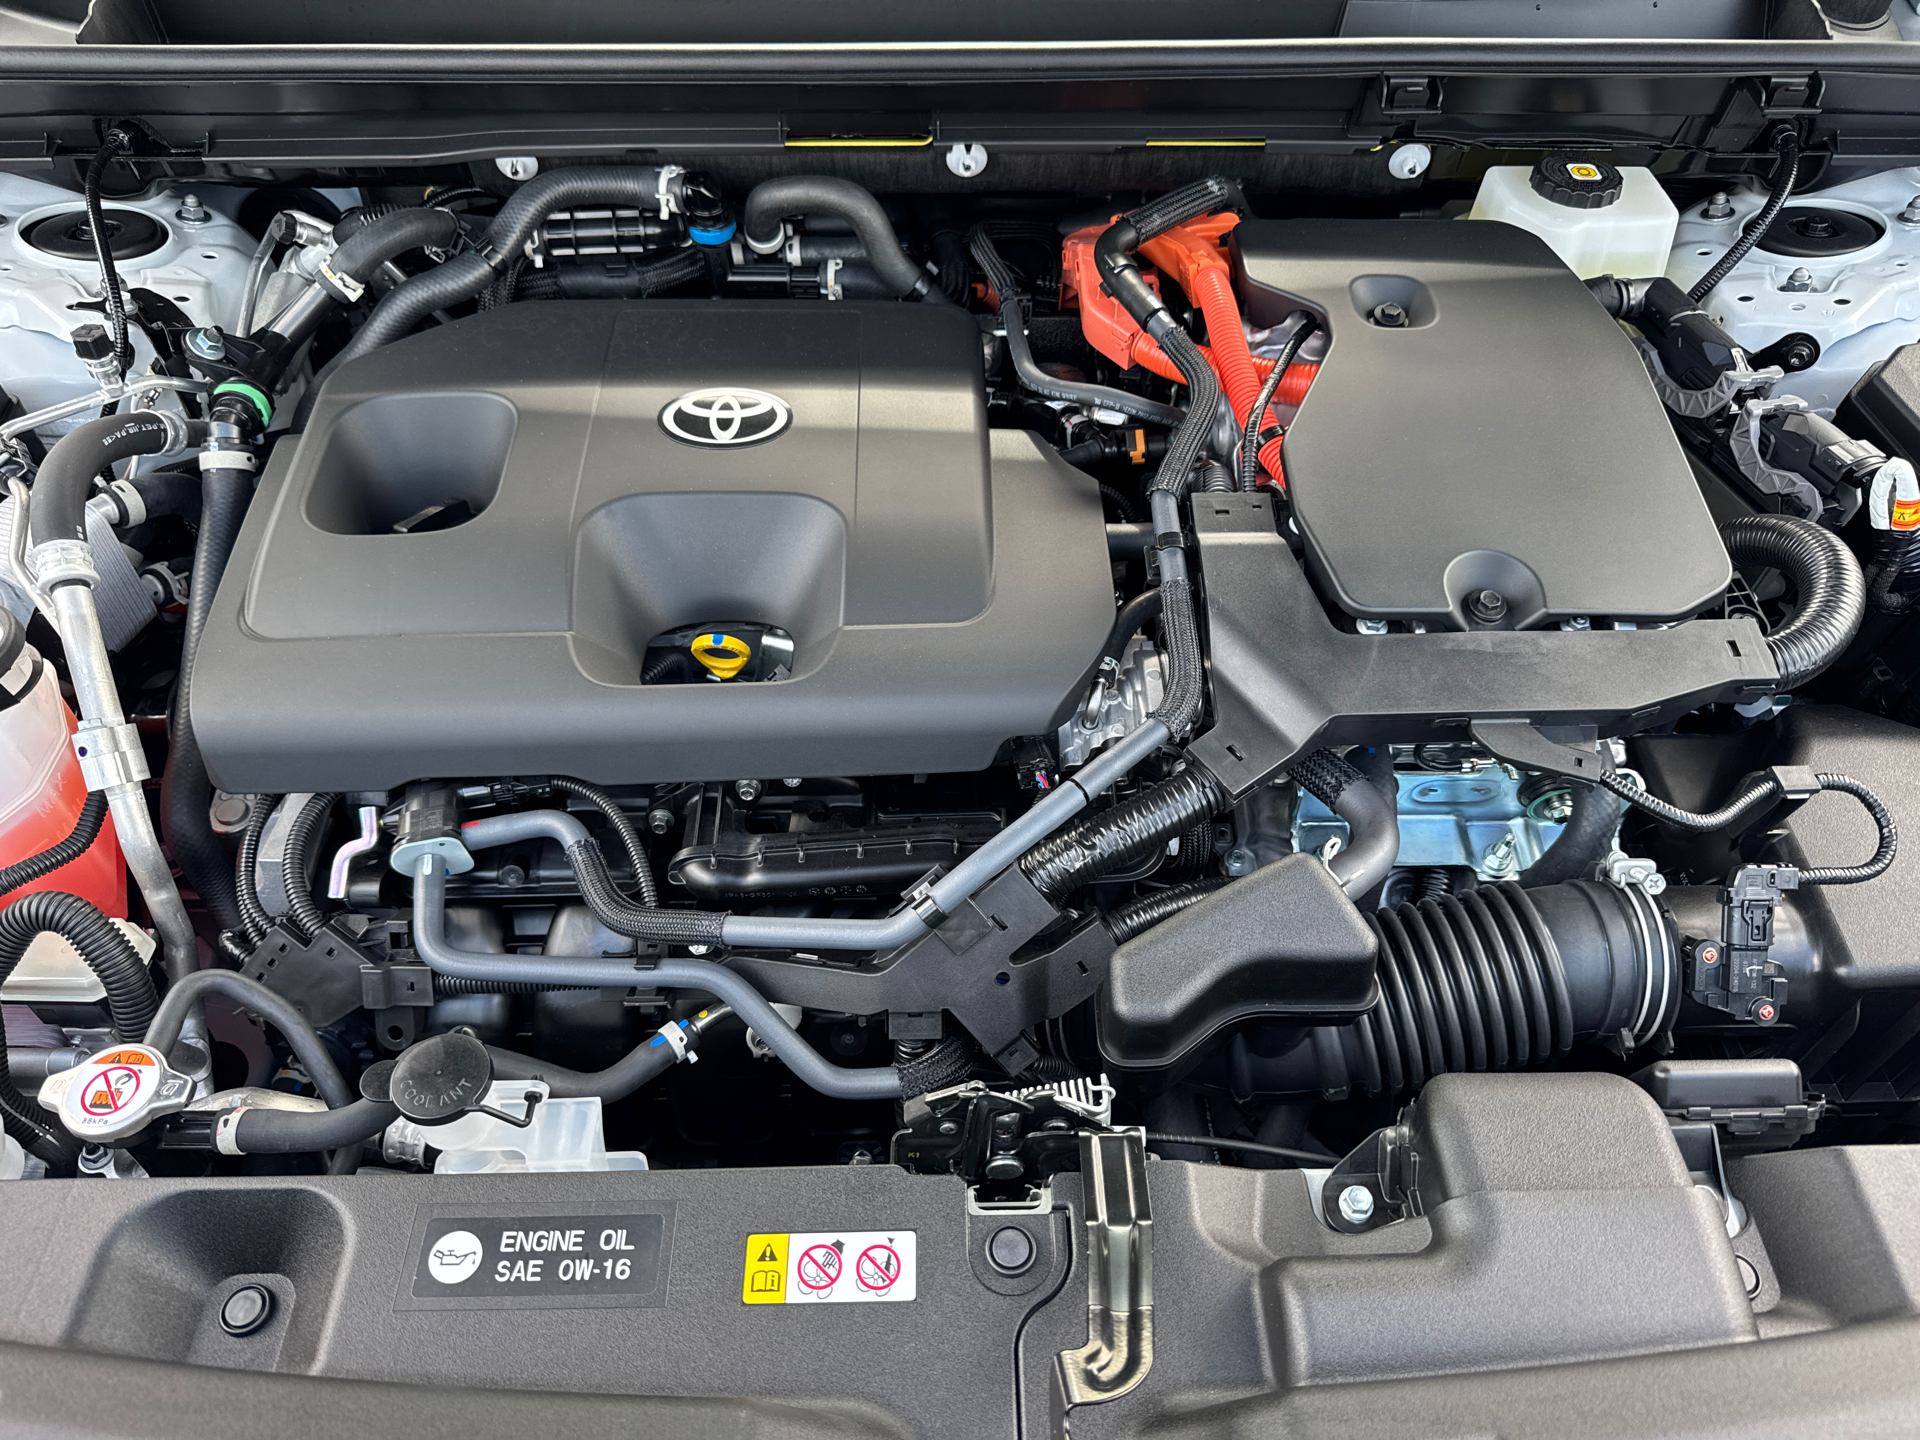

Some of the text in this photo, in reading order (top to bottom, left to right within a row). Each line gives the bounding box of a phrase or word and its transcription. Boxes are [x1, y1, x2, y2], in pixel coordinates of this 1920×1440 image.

[400, 1077, 472, 1108] COOLANT
[81, 1116, 109, 1125] 88kPa
[499, 1229, 635, 1252] ENGINE OIL
[494, 1258, 632, 1282] SAE 0W-16
